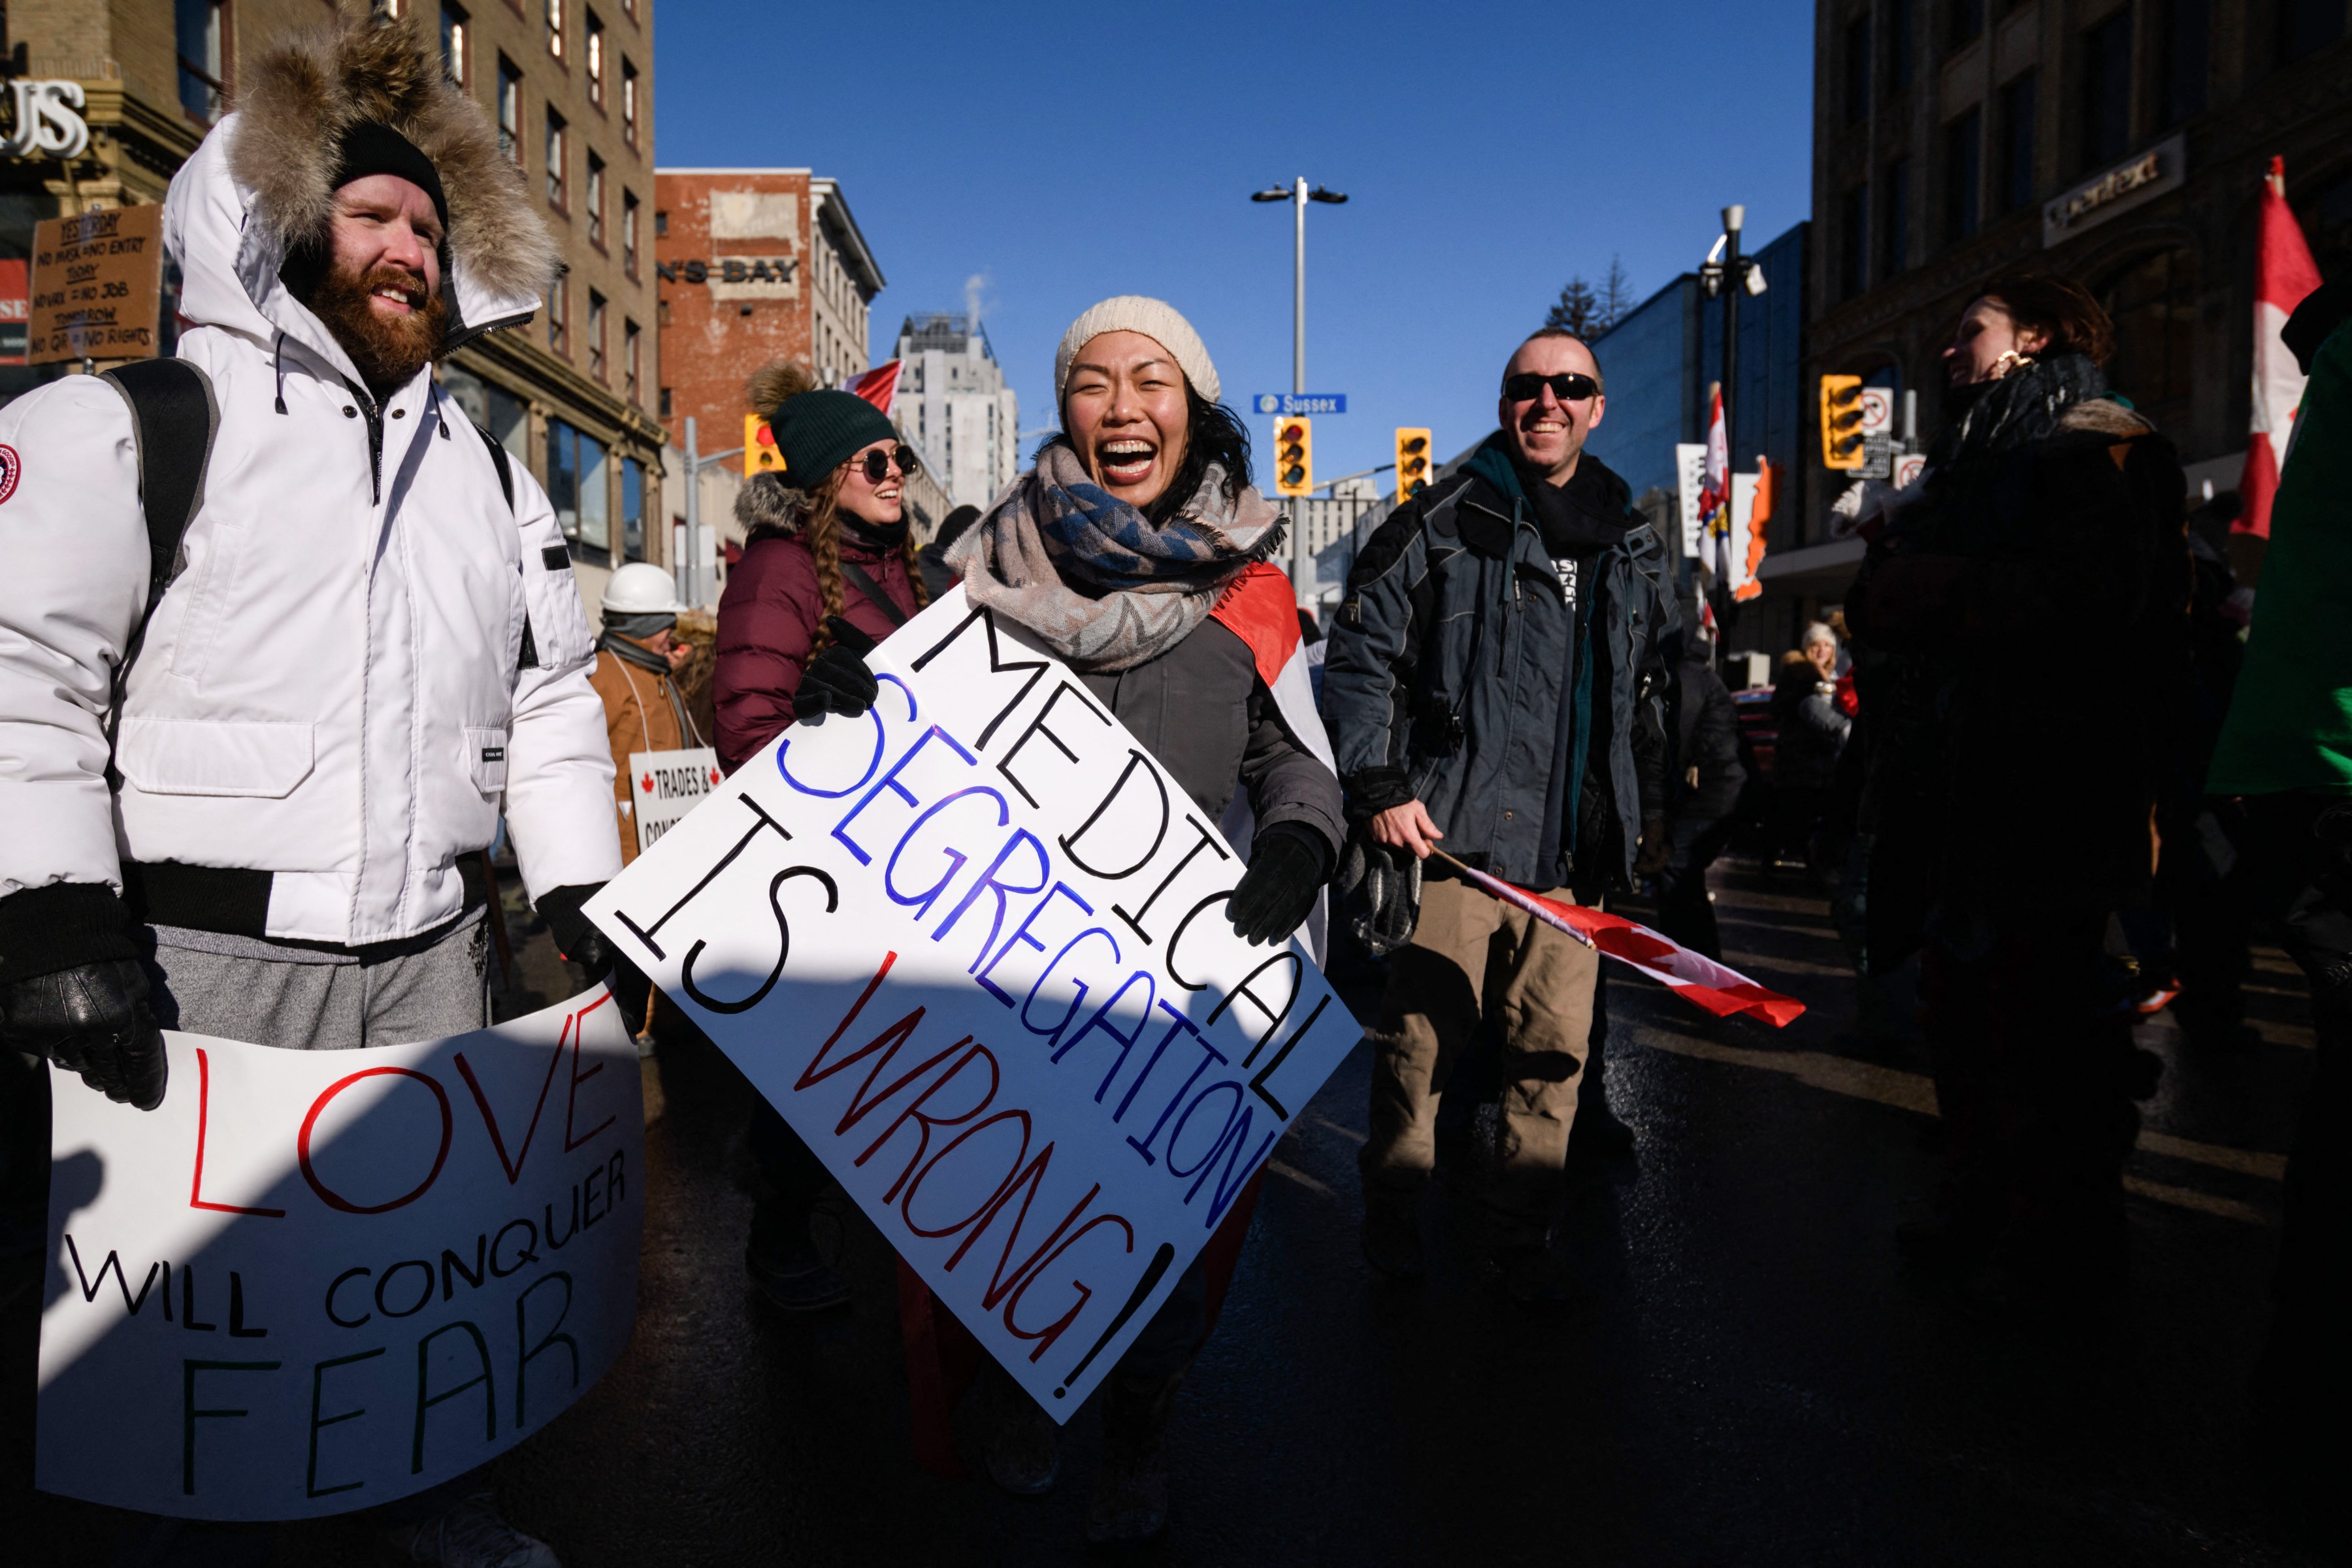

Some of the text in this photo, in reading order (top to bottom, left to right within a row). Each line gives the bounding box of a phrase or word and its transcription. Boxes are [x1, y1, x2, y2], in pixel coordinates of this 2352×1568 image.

[61, 213, 122, 240] YESTERDAY
[38, 253, 52, 267] NO
[56, 247, 80, 263] MASK
[110, 237, 146, 255] ENTRY
[67, 263, 99, 280] TODAY
[723, 259, 800, 283] BAY
[81, 287, 97, 301] NO
[101, 282, 129, 299] JOB
[55, 306, 116, 325] TOMORROW
[31, 337, 46, 355] NO
[51, 334, 67, 352] QR
[83, 331, 104, 347] NO
[108, 327, 150, 346] RIGHTS
[1284, 395, 1337, 412] Sussex
[655, 764, 710, 799] TRADES &
[912, 604, 1332, 1120] MEDICAL
[615, 792, 838, 1015] IS
[777, 671, 1275, 1229] SEGREGATION
[190, 988, 616, 1218] LOVE
[65, 1150, 625, 1337] WILL CONQUER
[184, 1271, 580, 1498] FEAR
